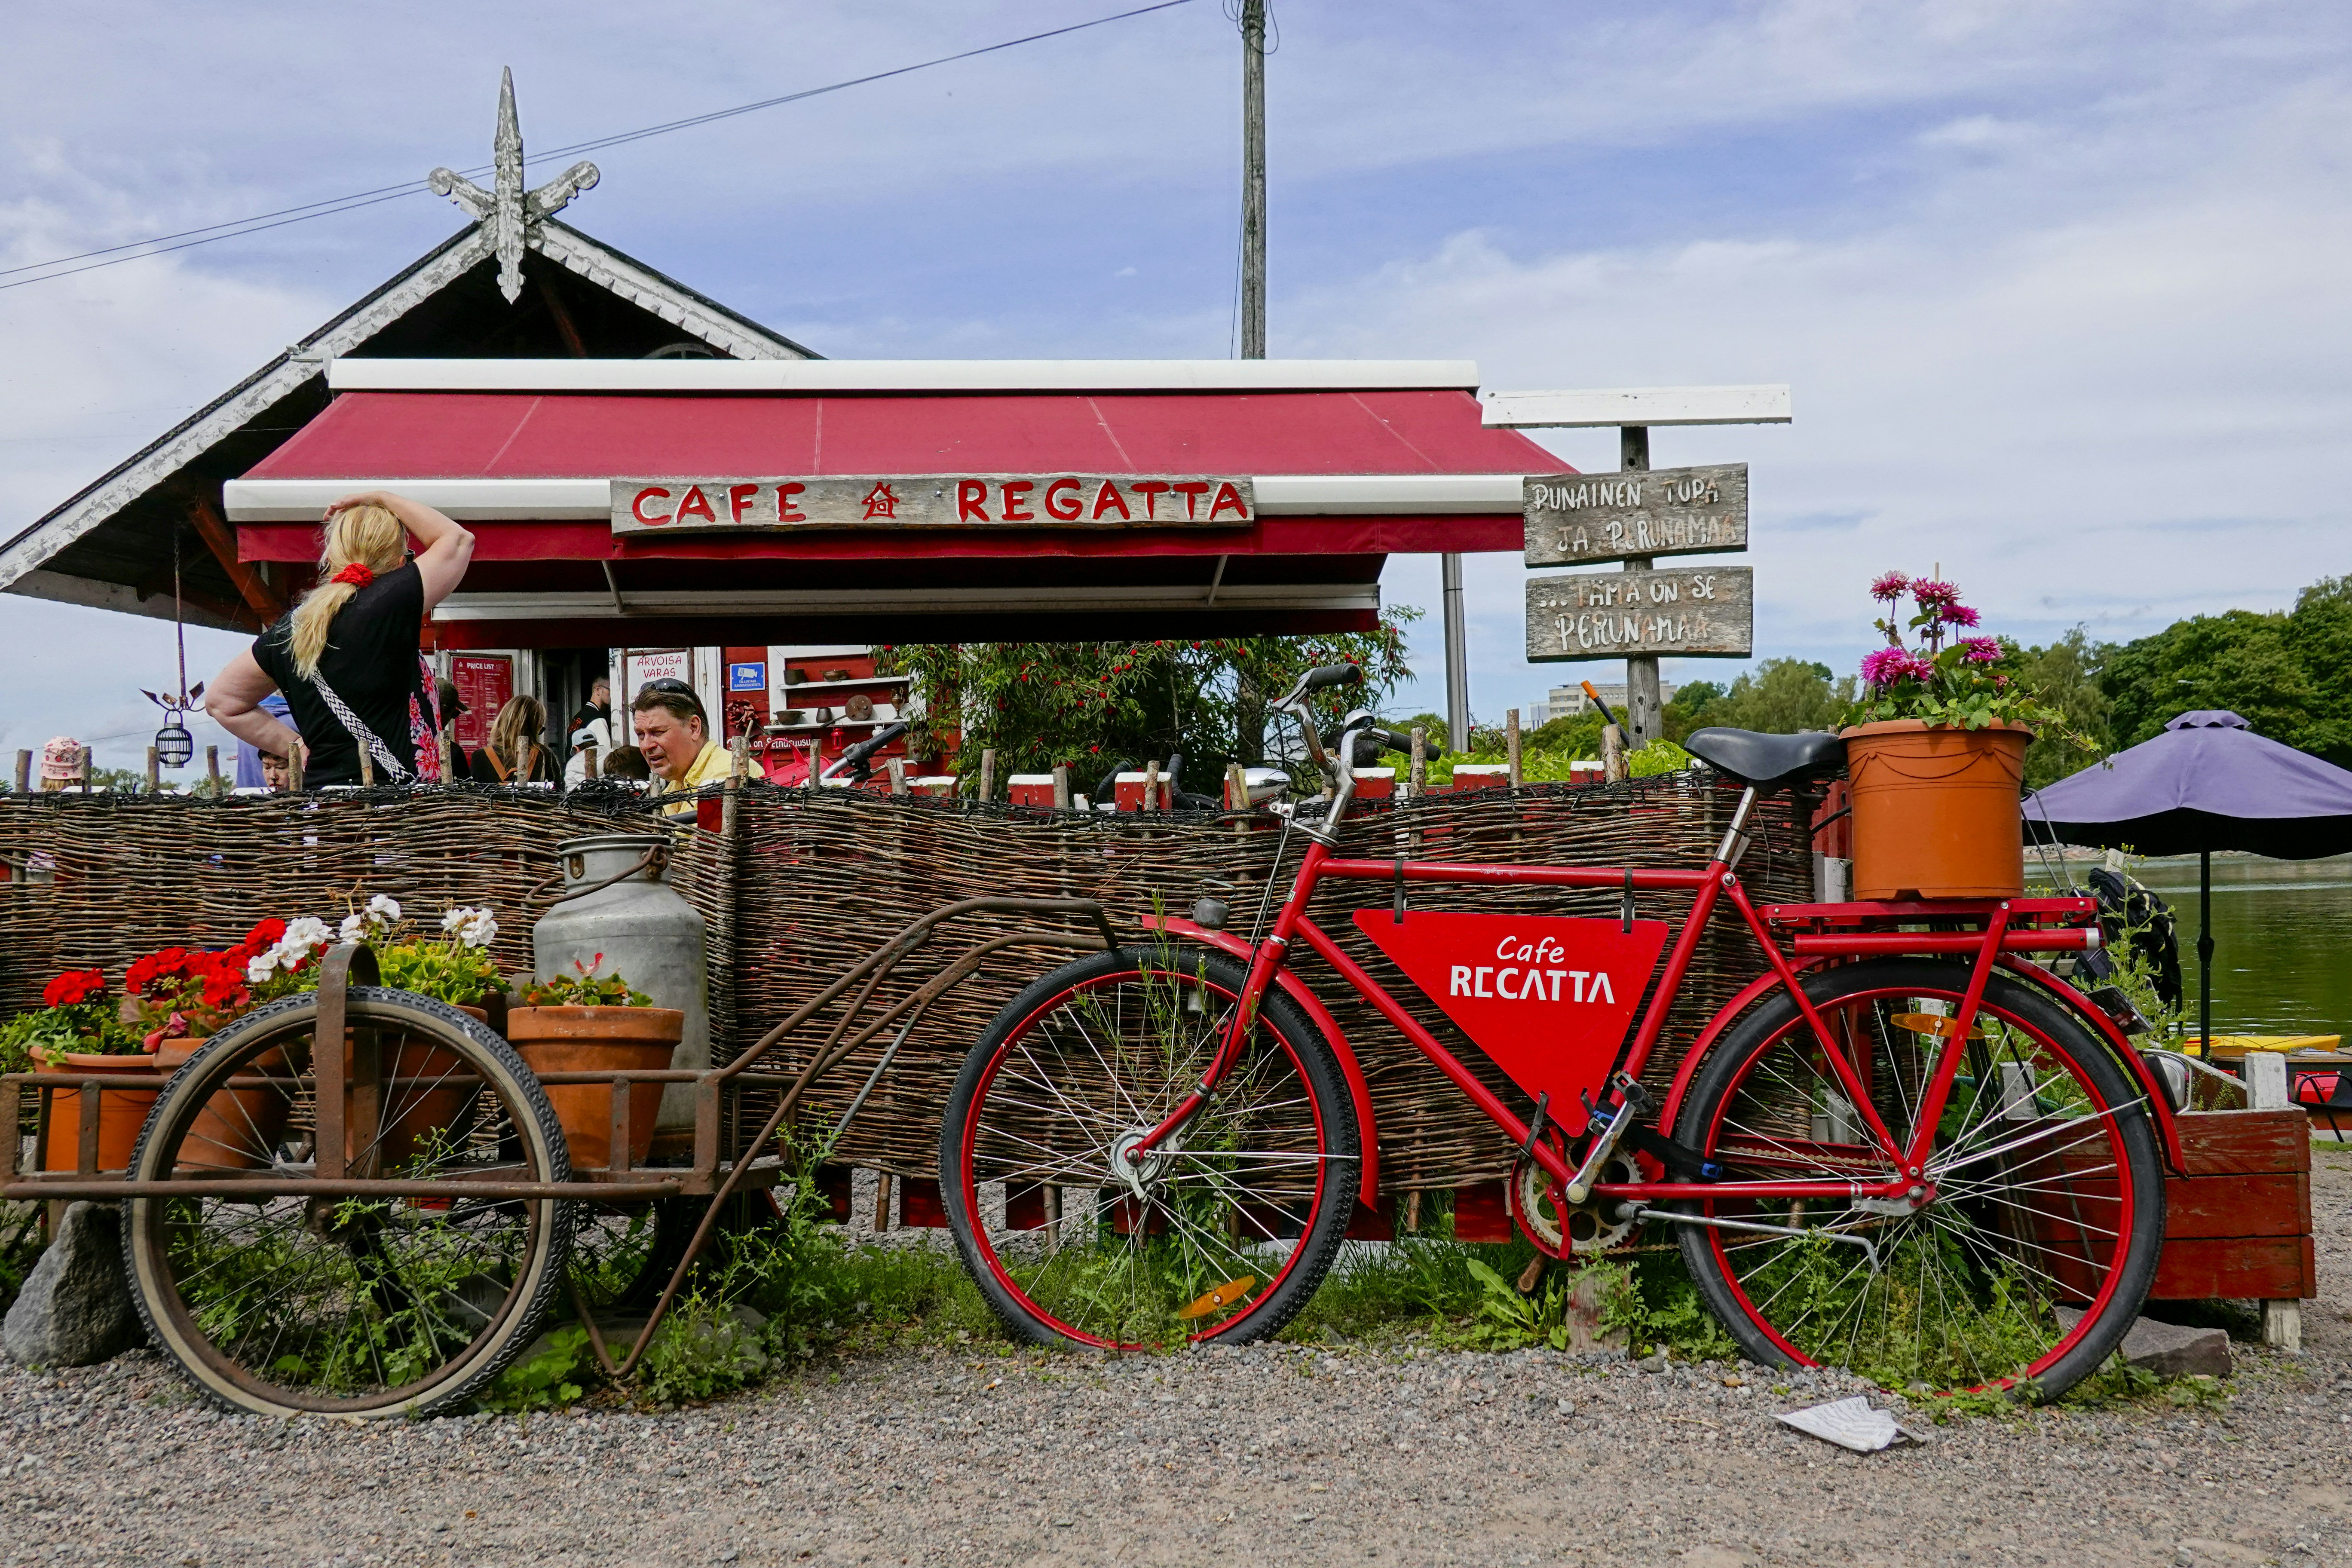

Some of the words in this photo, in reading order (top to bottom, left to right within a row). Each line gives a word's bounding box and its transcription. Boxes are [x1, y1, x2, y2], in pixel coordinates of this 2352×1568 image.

[632, 482, 807, 526] CAFE
[955, 478, 1248, 523] REGATTA
[1531, 481, 1642, 511] PUNAINEN
[1659, 478, 1719, 504] TUPA
[1557, 525, 1589, 552] JA
[1605, 514, 1737, 550] PERUNAMAA
[1649, 579, 1678, 603] ON
[1691, 575, 1717, 600] SE
[637, 655, 682, 666] ARVOISA
[643, 668, 676, 679] VARAS
[753, 740, 763, 748] on
[1496, 935, 1565, 964] Cafe
